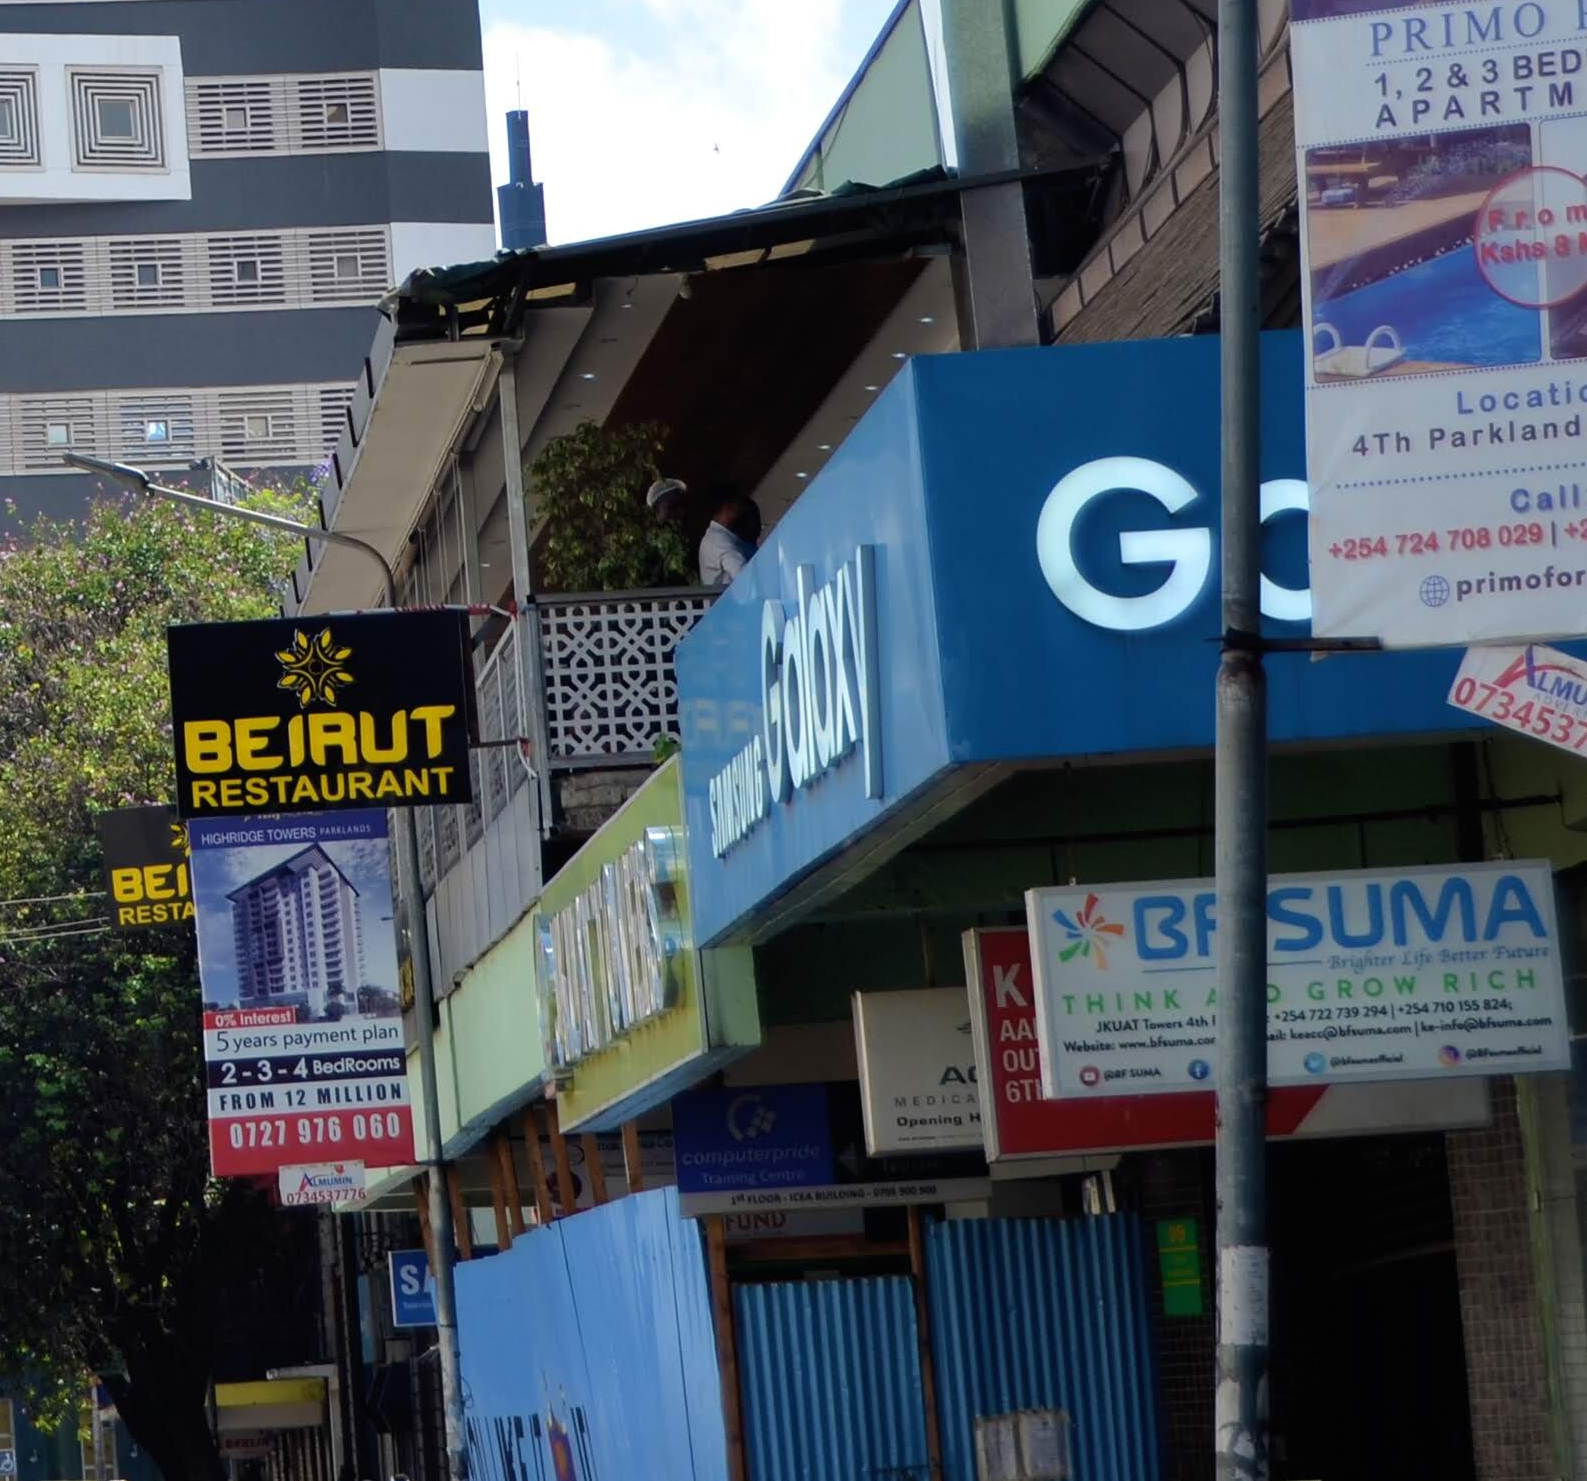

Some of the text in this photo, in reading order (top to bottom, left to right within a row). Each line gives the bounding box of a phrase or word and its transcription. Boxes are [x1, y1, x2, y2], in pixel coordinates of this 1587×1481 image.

[1369, 2, 1545, 57] PRIMO
[1375, 72, 1402, 100] 1,
[1416, 67, 1433, 92] 2
[1447, 63, 1469, 88] &
[1482, 59, 1499, 84] 3
[1375, 81, 1573, 129] APARTM
[1487, 205, 1587, 233] From
[1480, 239, 1546, 265] Kshs
[1554, 234, 1571, 257] 8
[1352, 414, 1581, 457] 4Th Parkland
[1329, 536, 1388, 560] +254
[1395, 531, 1439, 555] 724
[1447, 527, 1491, 551] 708
[1498, 522, 1543, 547] 029
[761, 544, 880, 803] Galaxy
[184, 705, 455, 774] BEIRUT
[191, 767, 454, 808] RESTAURANT
[709, 735, 764, 858] SAMSUNG
[201, 824, 371, 845] HIGHRIDGE TOWERS PARKLANDS
[1266, 875, 1547, 952] SUMA
[1328, 945, 1548, 974] Brighter Life Better Future
[1062, 989, 1181, 1015] THINK
[1307, 975, 1416, 1001] GROW
[1443, 968, 1535, 993] RICH
[215, 1010, 291, 1027] 0% Interest
[1097, 1019, 1139, 1033] JKUAT
[1142, 1018, 1182, 1030] Towers
[1186, 1015, 1208, 1027] 4th
[1275, 1010, 1307, 1022] +254
[1309, 1009, 1332, 1020] 722
[1336, 1007, 1359, 1018] 739
[1362, 1005, 1387, 1017] 294
[1398, 1002, 1429, 1015] +254
[1433, 1001, 1455, 1013] 710
[1458, 1000, 1481, 1011] 155
[216, 1024, 399, 1054] 5 years payment plan
[1000, 1018, 1039, 1042] AA
[1064, 1041, 1115, 1053] Website:
[312, 1056, 400, 1075] BedRooms
[1130, 1068, 1161, 1078] SUMA
[219, 1083, 401, 1111] FROM 12 MILLION
[229, 1112, 400, 1149] 0727 976 060
[897, 1115, 962, 1128] Opening
[682, 1143, 821, 1167] computerpride
[299, 1172, 353, 1193] ALMUMIN
[701, 1168, 805, 1186] Training Centre
[286, 1188, 366, 1205] 0734537776
[747, 1192, 781, 1205] FLOOR
[816, 1188, 865, 1201] BUILDING
